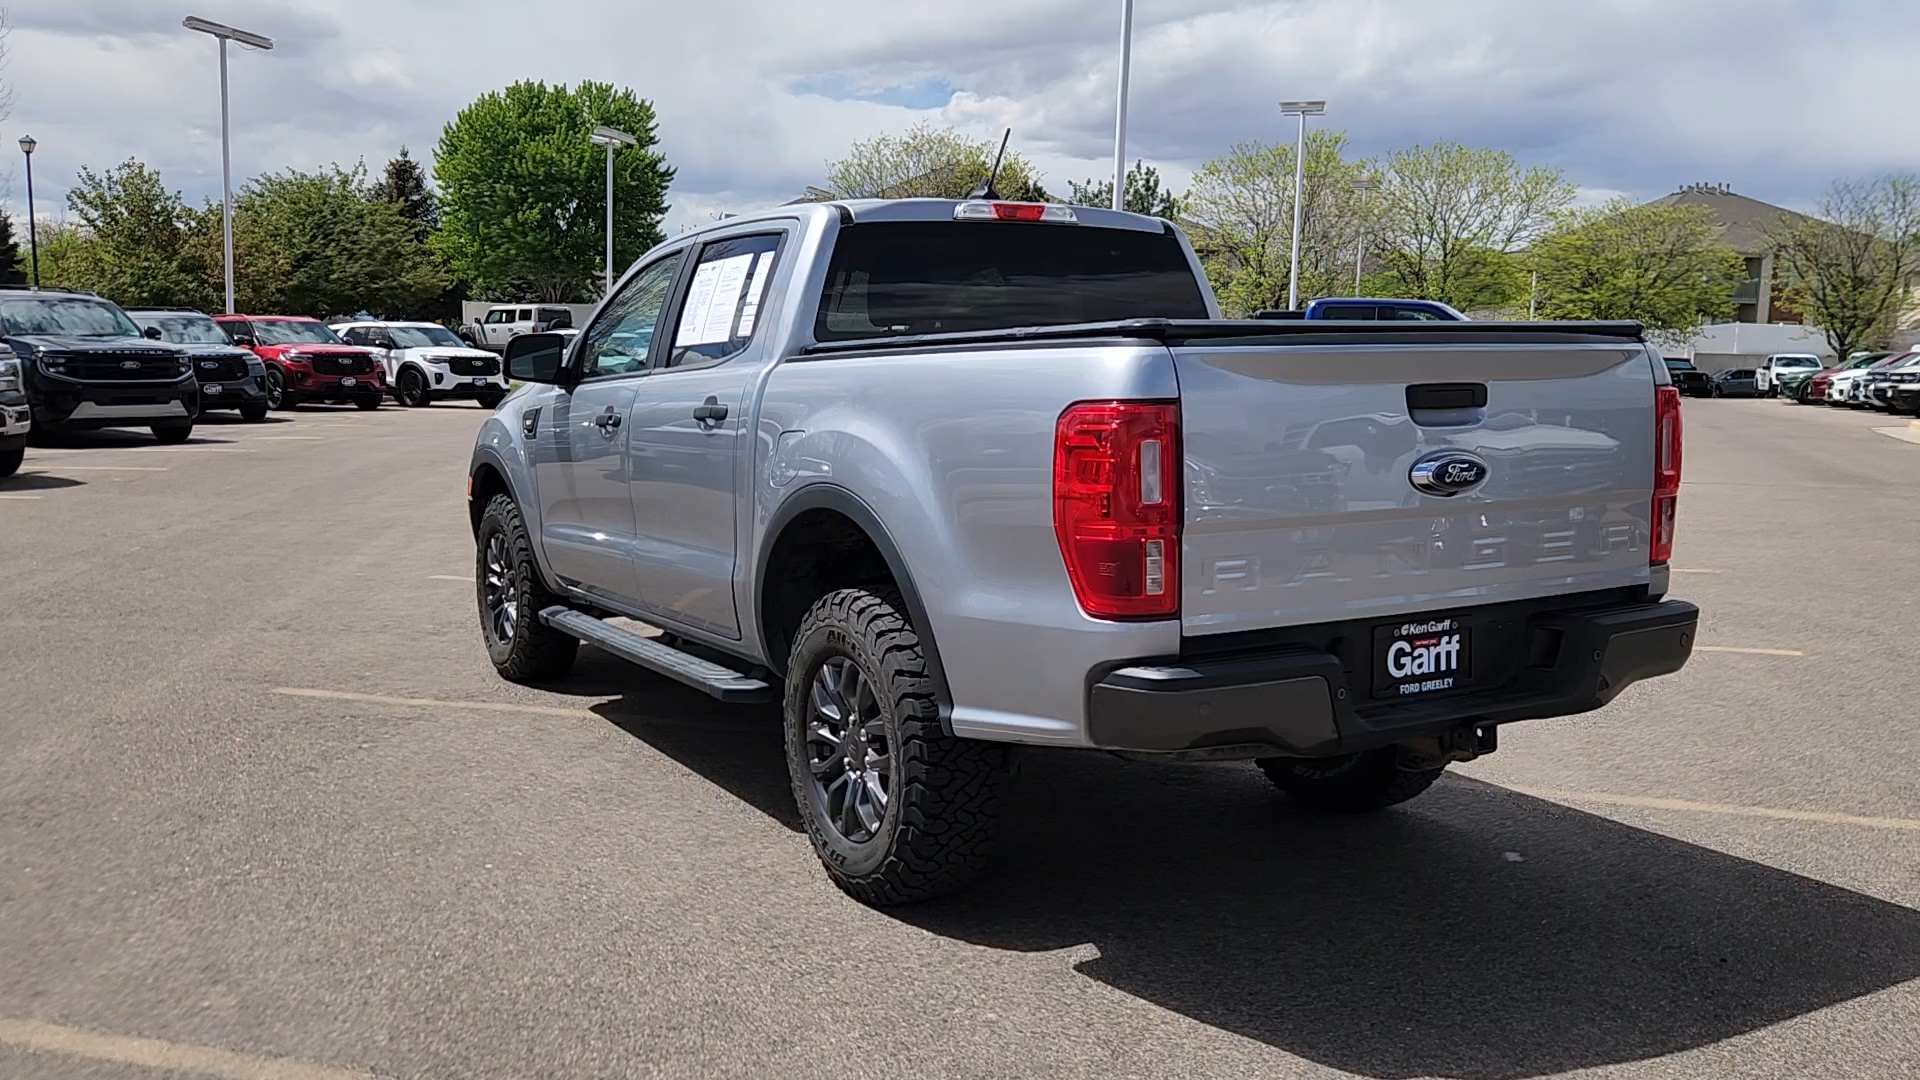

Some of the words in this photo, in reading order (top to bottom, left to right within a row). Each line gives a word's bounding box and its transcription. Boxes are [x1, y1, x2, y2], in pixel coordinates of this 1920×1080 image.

[1445, 463, 1477, 483] Ford
[1202, 524, 1640, 595] RANGER
[1410, 623, 1427, 635] Ken
[1428, 619, 1451, 632] Garff
[1387, 634, 1460, 678] Garff
[1400, 682, 1420, 695] FORD
[1421, 677, 1453, 692] GREELEY
